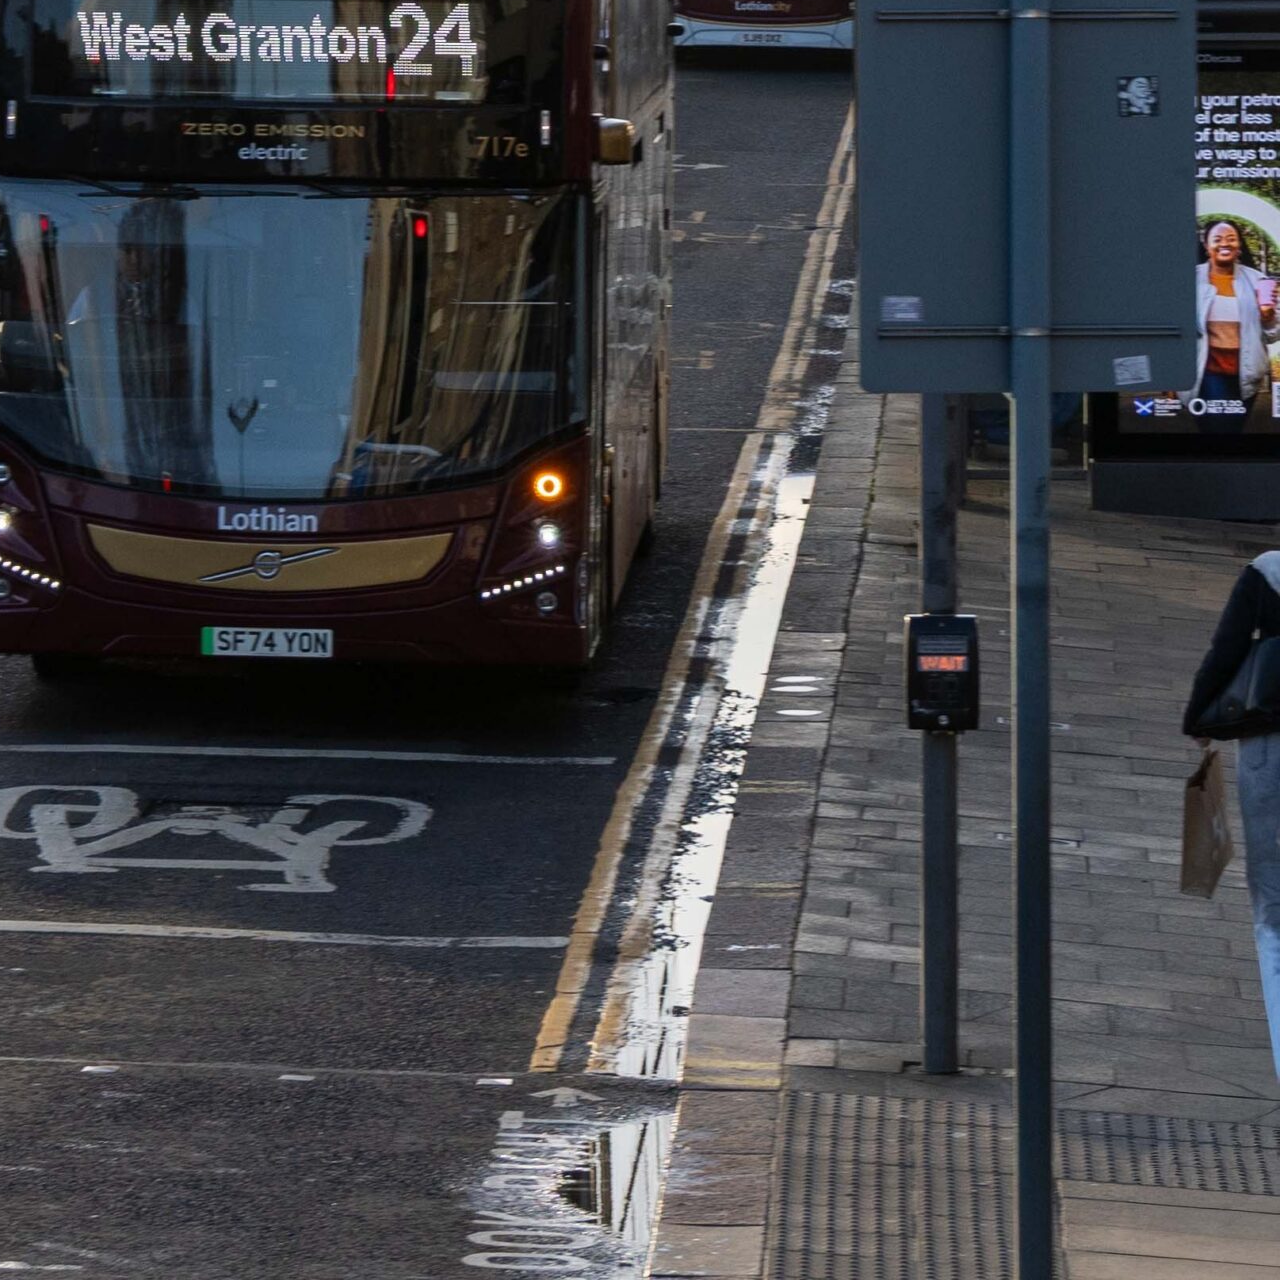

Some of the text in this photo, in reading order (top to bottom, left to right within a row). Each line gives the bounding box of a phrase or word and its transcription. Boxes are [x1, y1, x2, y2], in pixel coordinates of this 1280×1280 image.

[77, 2, 478, 77] West Granton 24
[1201, 95, 1239, 110] your
[1241, 93, 1280, 109] petro
[1212, 113, 1239, 124] car
[1240, 110, 1273, 124] less
[182, 123, 366, 138] ZERO EMISSION
[1213, 128, 1240, 142] the
[238, 141, 310, 161] electric
[476, 135, 529, 159] 717e
[1215, 148, 1257, 163] ways
[1258, 147, 1277, 161] to
[1212, 163, 1280, 179] emission
[217, 506, 318, 532] Lothian
[217, 631, 328, 654] SF74 YON
[919, 656, 966, 672] WAIT
